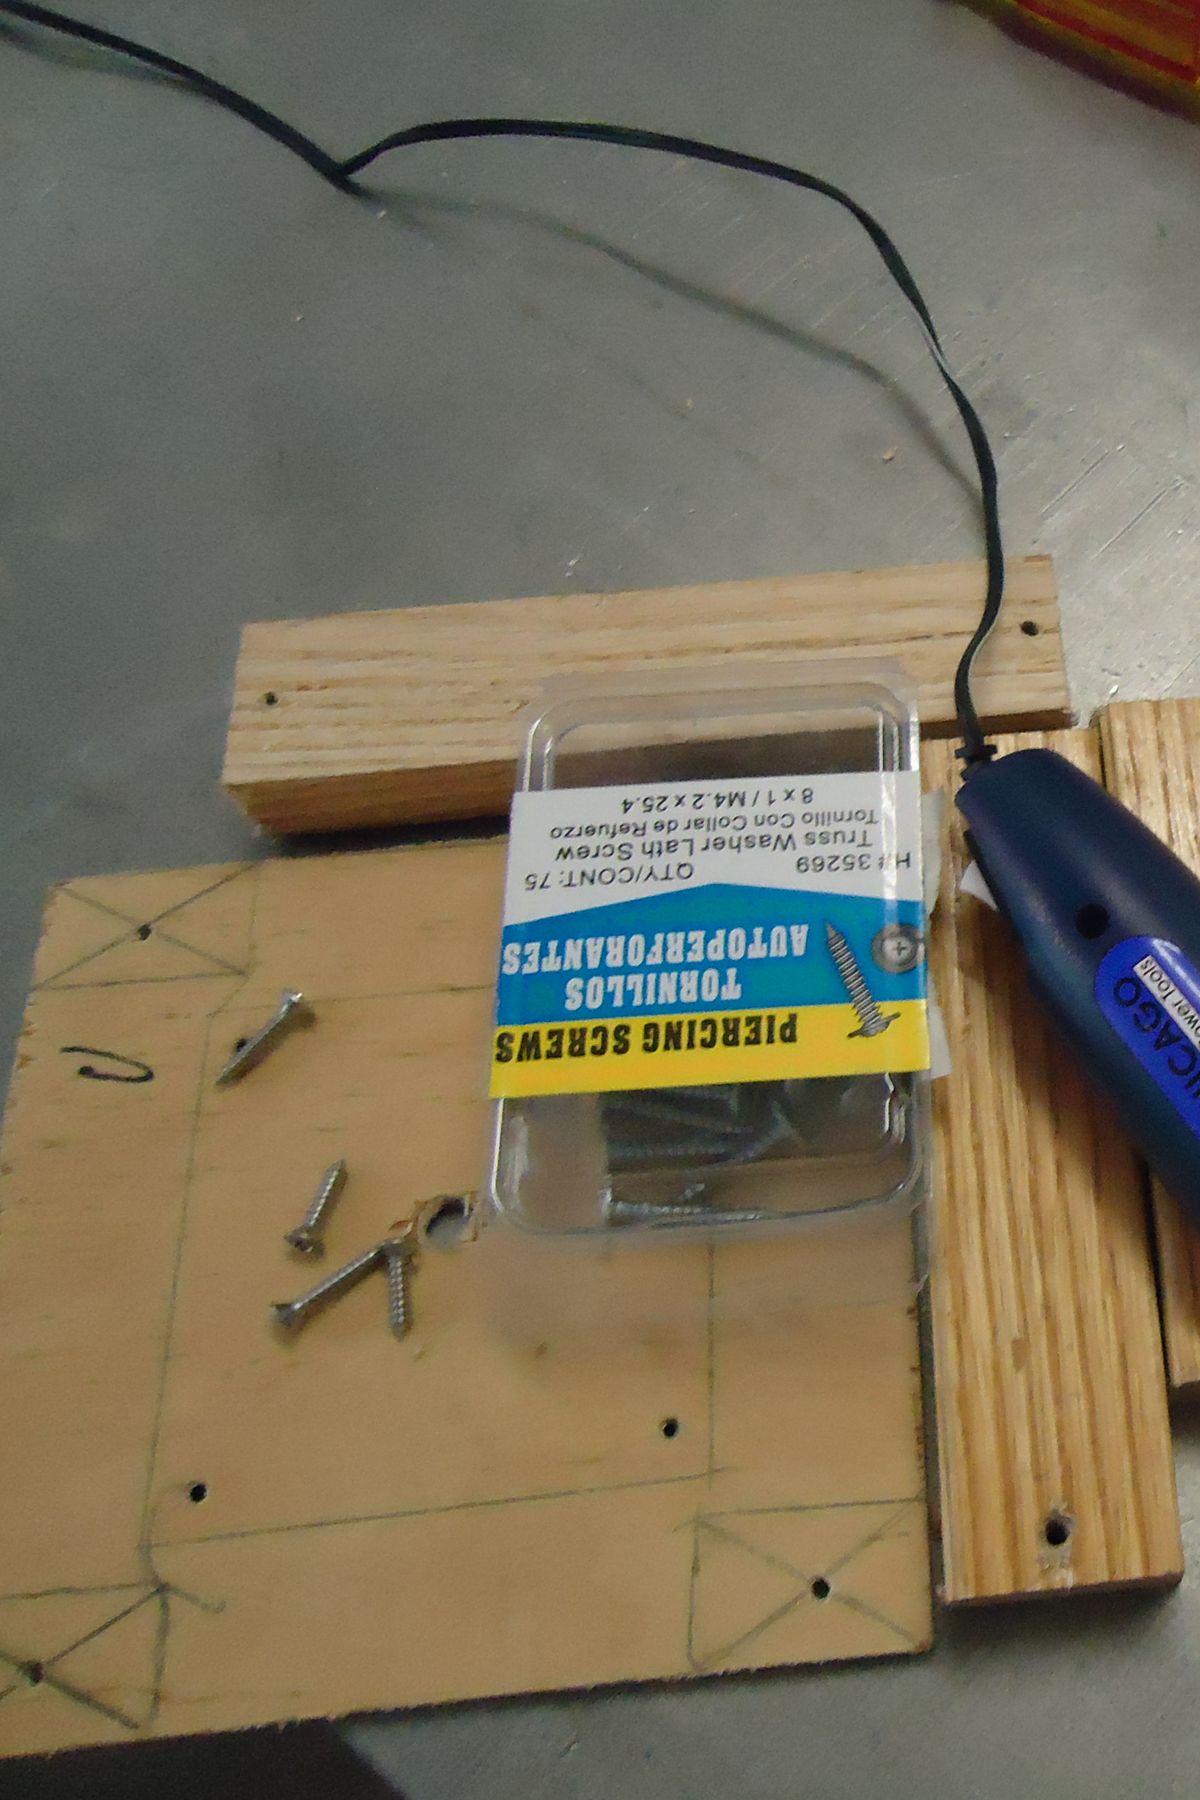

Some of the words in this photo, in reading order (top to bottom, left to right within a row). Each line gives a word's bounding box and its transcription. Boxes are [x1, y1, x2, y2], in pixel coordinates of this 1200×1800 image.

[674, 794, 687, 808] x
[692, 792, 746, 811] M4.2
[752, 790, 760, 808] /
[768, 790, 777, 804] 1
[784, 788, 796, 802] x
[801, 787, 814, 804] 8
[622, 796, 669, 814] 25.4
[654, 819, 677, 833] de
[683, 815, 747, 832] Collar
[754, 812, 795, 829] Con
[802, 809, 880, 827] Tornillo
[550, 821, 647, 839] Refuerzo
[805, 829, 872, 847] Truss
[641, 839, 694, 860] Lath
[701, 833, 796, 853] Washer
[555, 845, 633, 861] Screw
[796, 853, 871, 873] 35269
[525, 872, 550, 891] 75
[559, 862, 694, 888] QTY/CONT:
[502, 924, 809, 975] AUTOPERFORANTES
[1140, 957, 1176, 999] Tools
[565, 967, 742, 1010] TORNILLOS
[642, 1014, 798, 1053] PIERCING
[495, 1024, 631, 1062] SCREWS
